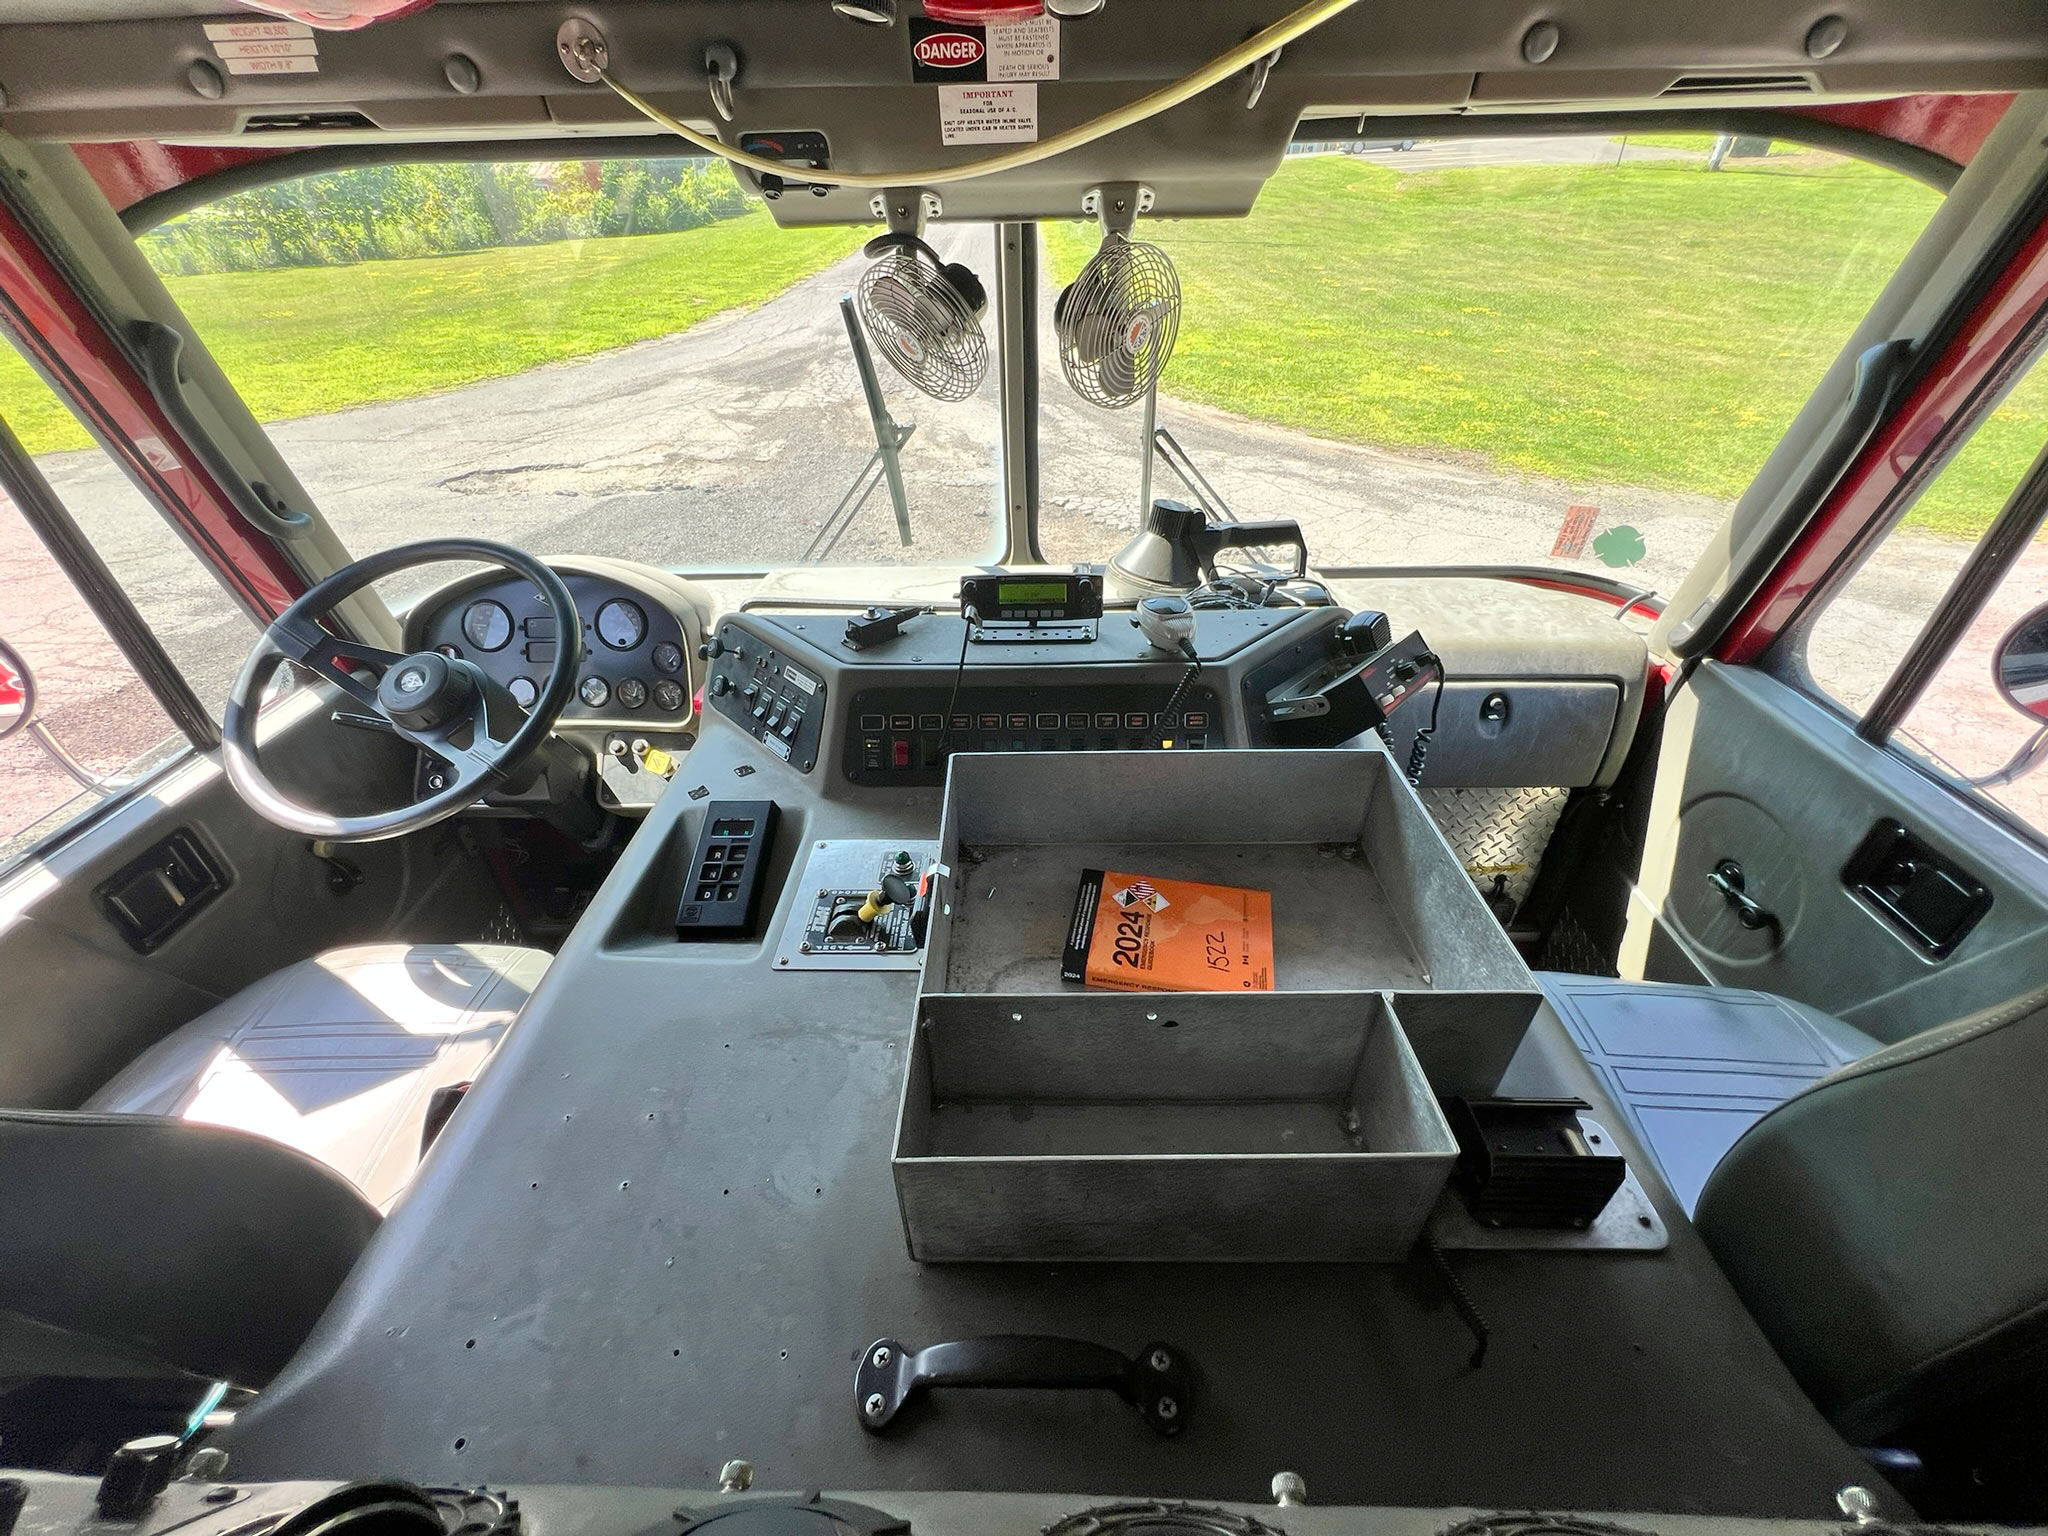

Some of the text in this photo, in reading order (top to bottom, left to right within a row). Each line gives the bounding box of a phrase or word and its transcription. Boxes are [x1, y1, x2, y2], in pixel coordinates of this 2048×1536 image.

[920, 41, 977, 60] DANGER
[962, 90, 1014, 99] IMPORTANT
[714, 851, 722, 859] R
[704, 891, 711, 899] D
[1112, 911, 1145, 968] 2024
[1140, 913, 1152, 970] EMERGENCY RESPONSE
[1147, 940, 1155, 971] GUIDEBOOK
[1205, 931, 1231, 973] 1522
[1063, 971, 1081, 979] 2024
[1091, 977, 1140, 988] EMERGENCY
